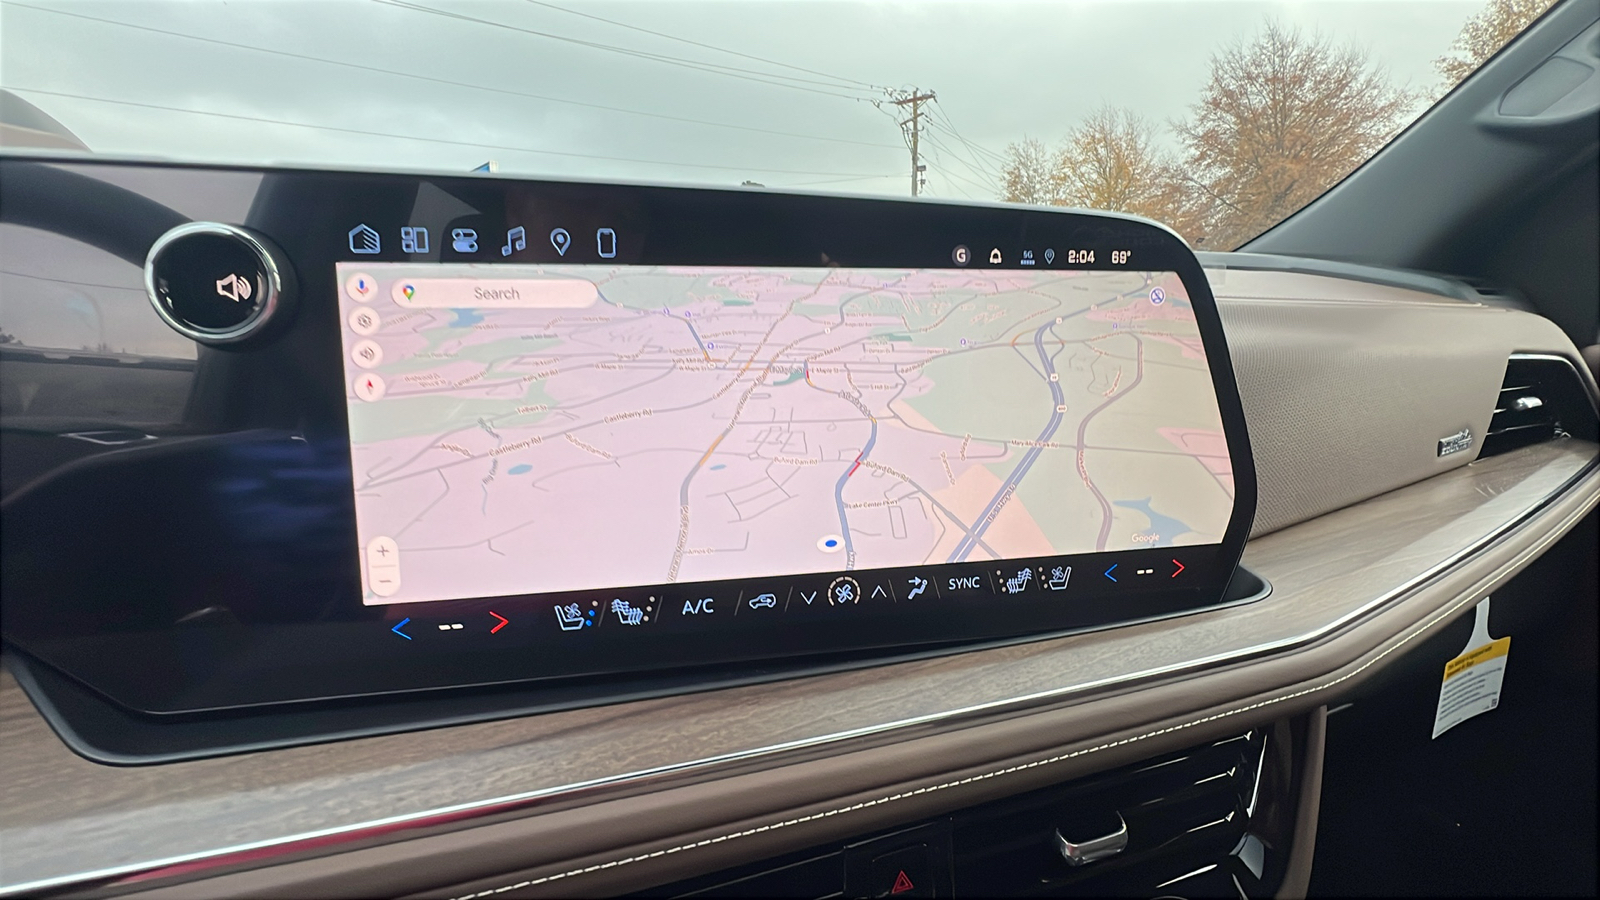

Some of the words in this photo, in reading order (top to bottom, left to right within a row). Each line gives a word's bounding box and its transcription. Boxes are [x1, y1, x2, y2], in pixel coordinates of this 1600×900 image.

[956, 248, 967, 263] G
[1023, 250, 1033, 259] 5G
[1068, 249, 1095, 264] 2:04
[474, 286, 520, 301] Search
[604, 410, 641, 424] Castleberry
[643, 408, 653, 417] Rd
[489, 439, 530, 457] Castleberry
[531, 436, 542, 446] Rd
[774, 456, 794, 464] Buford
[866, 461, 886, 472] Buford
[886, 467, 901, 478] Dam
[901, 474, 910, 482] Rd
[1132, 533, 1160, 544] Google
[948, 576, 981, 590] SYNC
[682, 598, 714, 616] A/C
